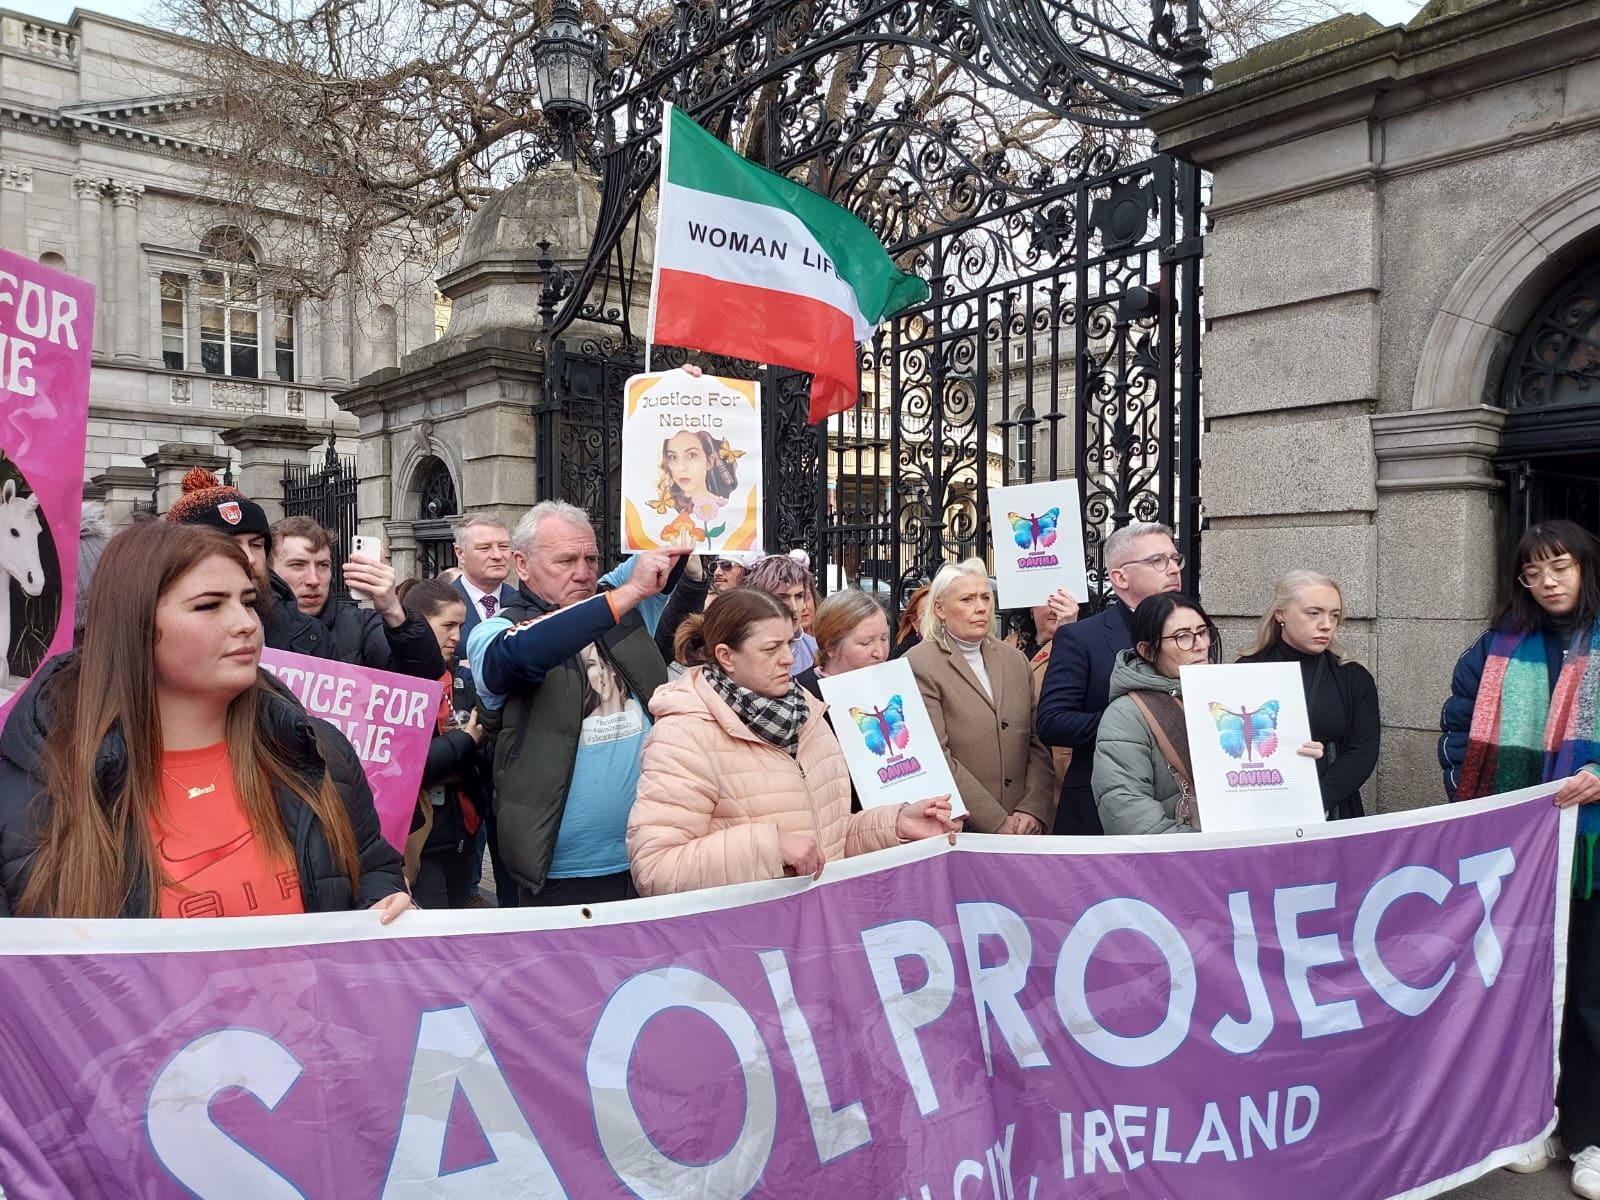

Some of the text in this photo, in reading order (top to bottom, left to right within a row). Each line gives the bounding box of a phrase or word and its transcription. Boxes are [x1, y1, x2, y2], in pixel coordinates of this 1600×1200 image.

[688, 221, 841, 281] WOMAN LIF
[642, 392, 741, 408] Justice For
[659, 413, 723, 428] Natalie
[1017, 554, 1059, 569] DAVINA
[364, 683, 429, 729] FOR
[321, 717, 395, 764] LIE
[877, 756, 921, 784] DAVINA
[1226, 768, 1283, 787] DAVINA
[144, 847, 1515, 1200] SAOL PROJECT
[1059, 1084, 1320, 1179] IRELAND
